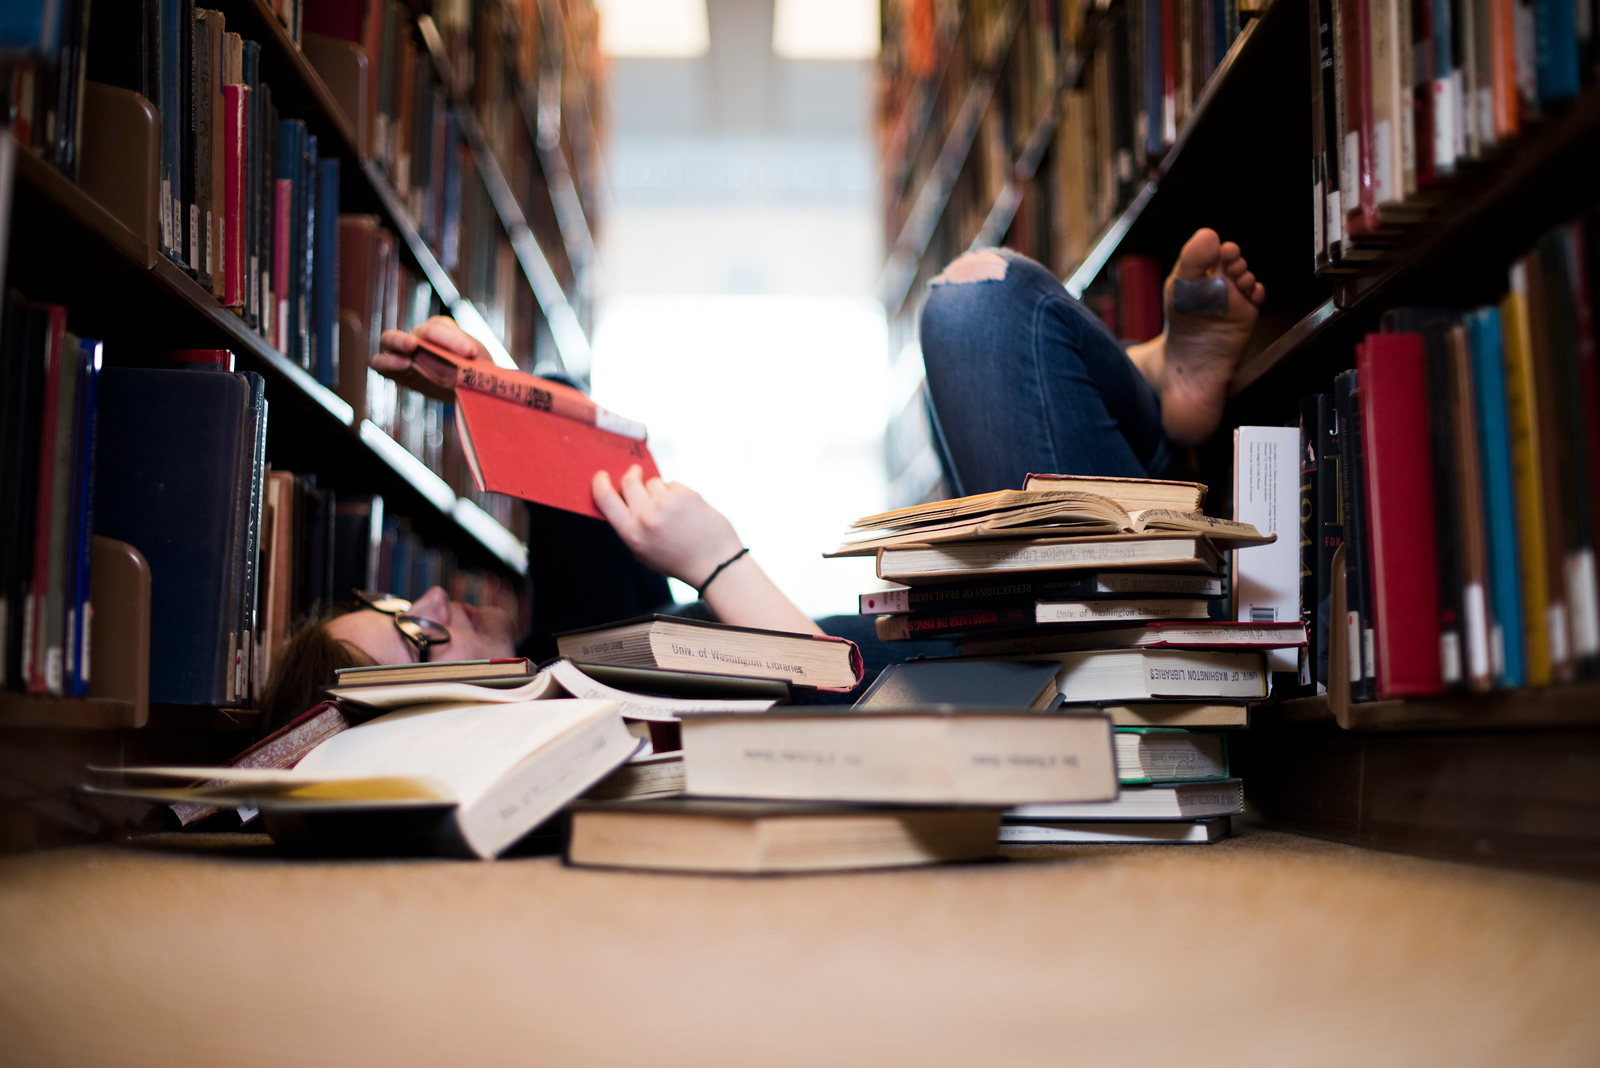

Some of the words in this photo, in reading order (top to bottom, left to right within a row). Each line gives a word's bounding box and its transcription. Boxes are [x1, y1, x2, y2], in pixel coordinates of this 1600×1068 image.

[1325, 536, 1341, 547] FDR
[1039, 548, 1096, 561] Washington
[936, 590, 960, 600] PEARL
[961, 588, 974, 599] OF
[975, 583, 1032, 597] REFLECTIONS
[910, 593, 933, 603] HARB
[1056, 609, 1075, 619] Univ.
[1079, 609, 1088, 618] of
[1091, 607, 1135, 618] Washington
[1138, 607, 1171, 616] Libraries
[915, 618, 935, 631] RISING
[937, 617, 948, 630] THE
[950, 613, 973, 627] UNDER
[672, 643, 695, 658] Univ.
[698, 647, 707, 659] of
[711, 649, 762, 668] Washington
[766, 660, 804, 675] Libraries
[1150, 668, 1186, 681] LIBRARIES
[1187, 670, 1229, 682] WASHINGTON
[1231, 671, 1240, 682] OF
[1241, 671, 1258, 682] UNIV.
